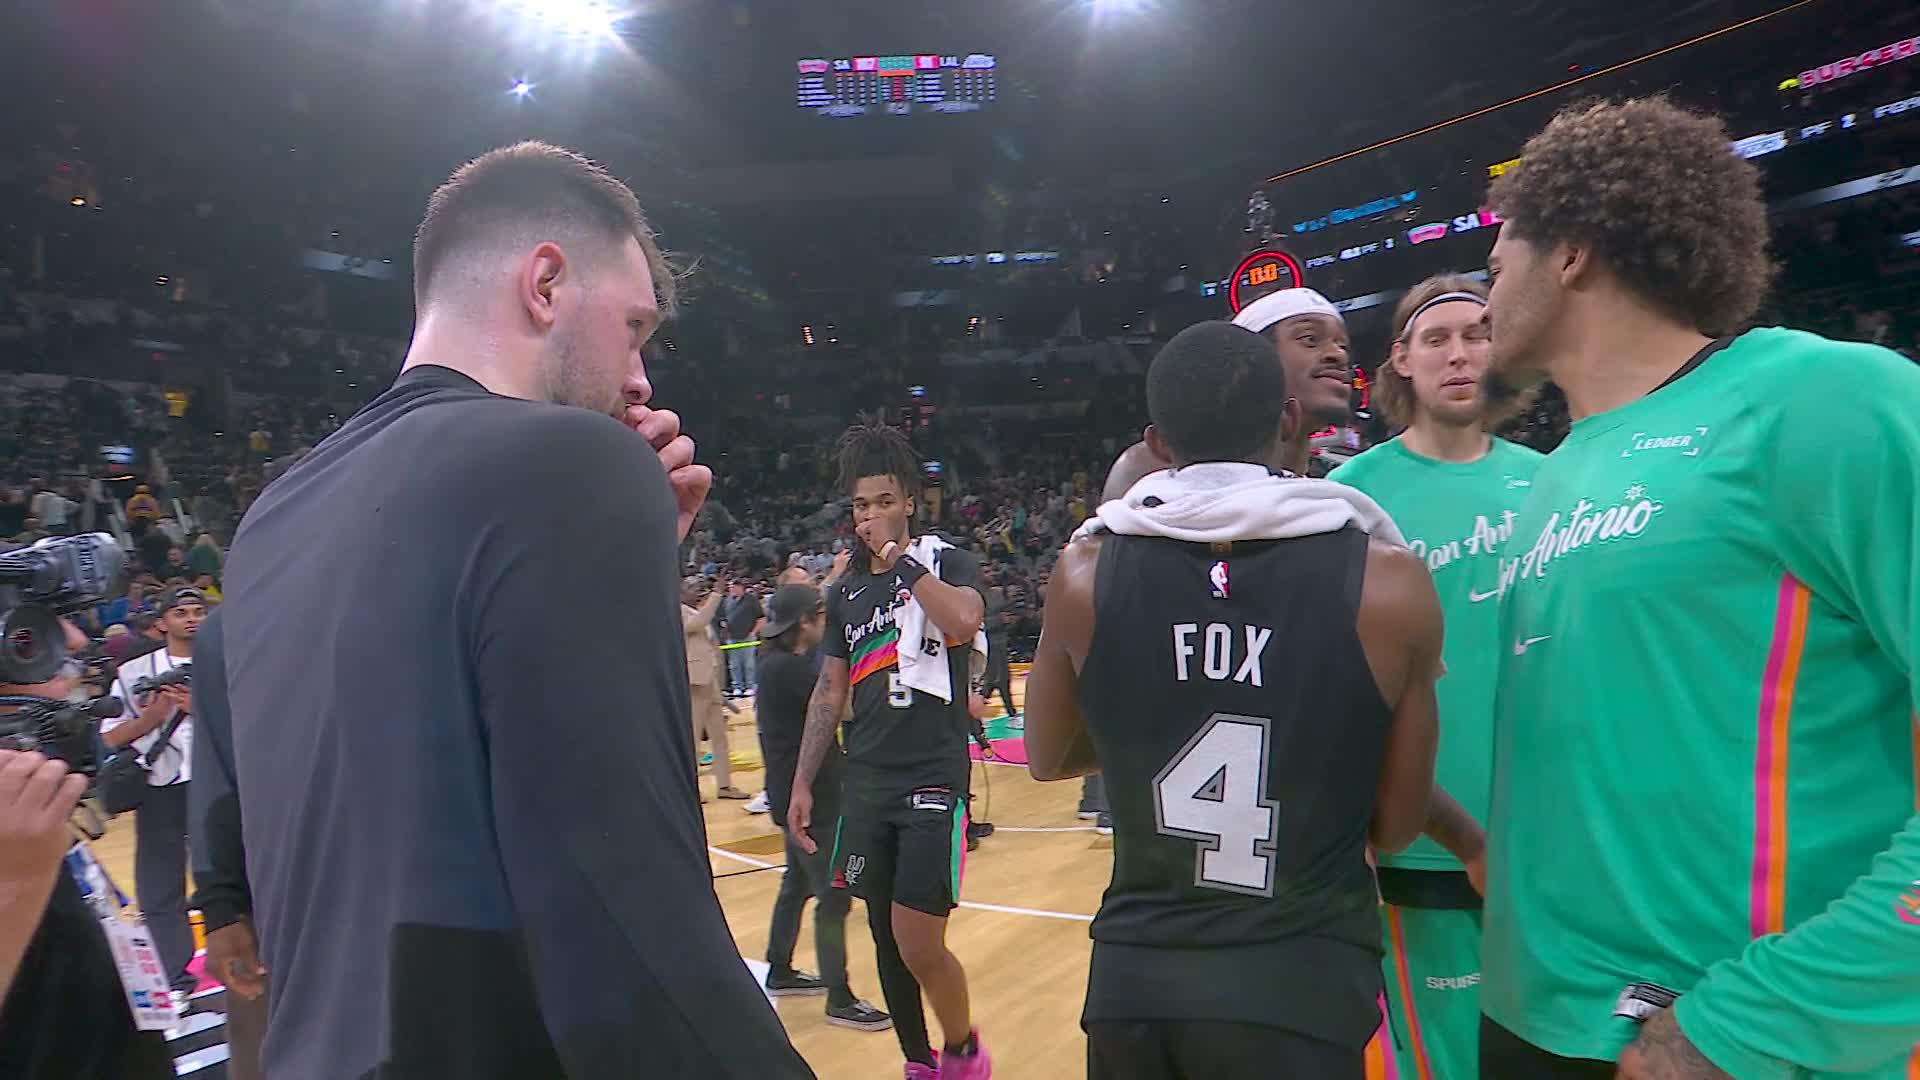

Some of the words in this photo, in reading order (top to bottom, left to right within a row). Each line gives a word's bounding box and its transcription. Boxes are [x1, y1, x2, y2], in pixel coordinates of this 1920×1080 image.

[1452, 213, 1479, 233] SA
[1634, 435, 1692, 450] LEDGER
[1511, 485, 1662, 579] Antonio
[1172, 622, 1273, 687] FOX
[888, 671, 913, 709] 5
[1151, 712, 1281, 898] 4
